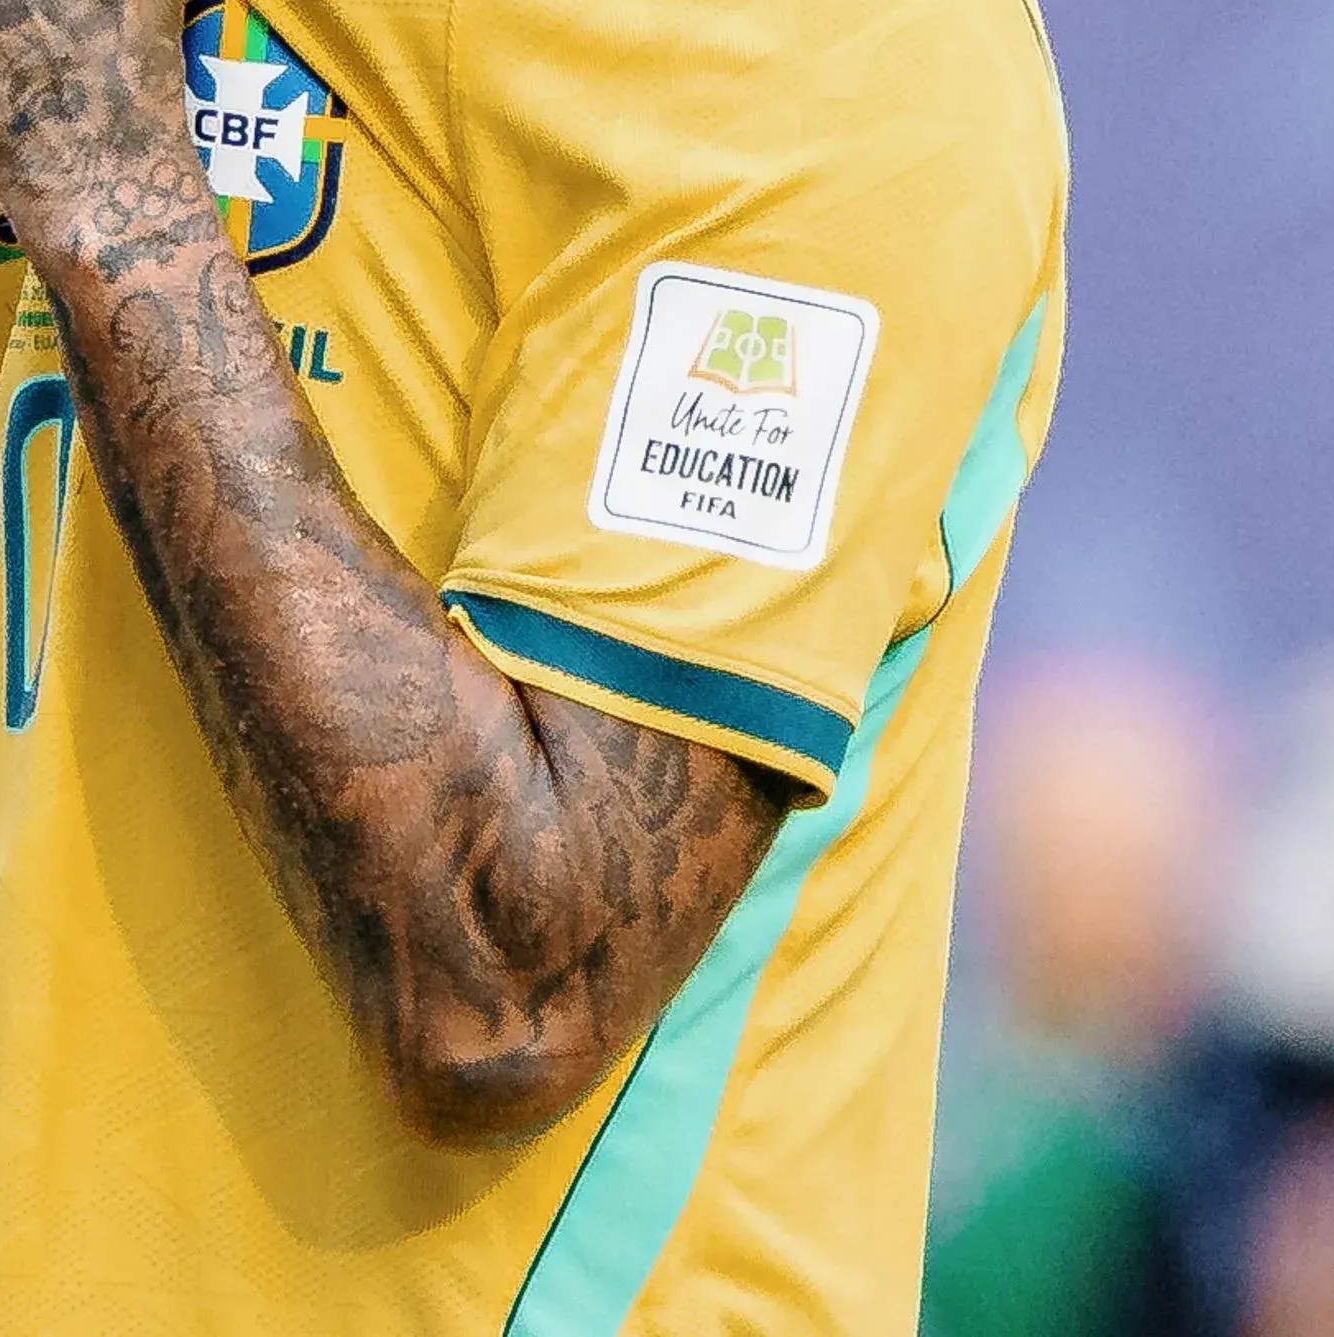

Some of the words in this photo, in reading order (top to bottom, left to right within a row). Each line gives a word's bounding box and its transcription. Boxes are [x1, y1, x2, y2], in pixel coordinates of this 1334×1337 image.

[195, 109, 279, 150] CBF
[272, 321, 344, 383] IL
[671, 392, 745, 437] Unite
[753, 408, 794, 446] For
[640, 438, 799, 502] EDUCATION
[680, 491, 736, 519] FIFA
